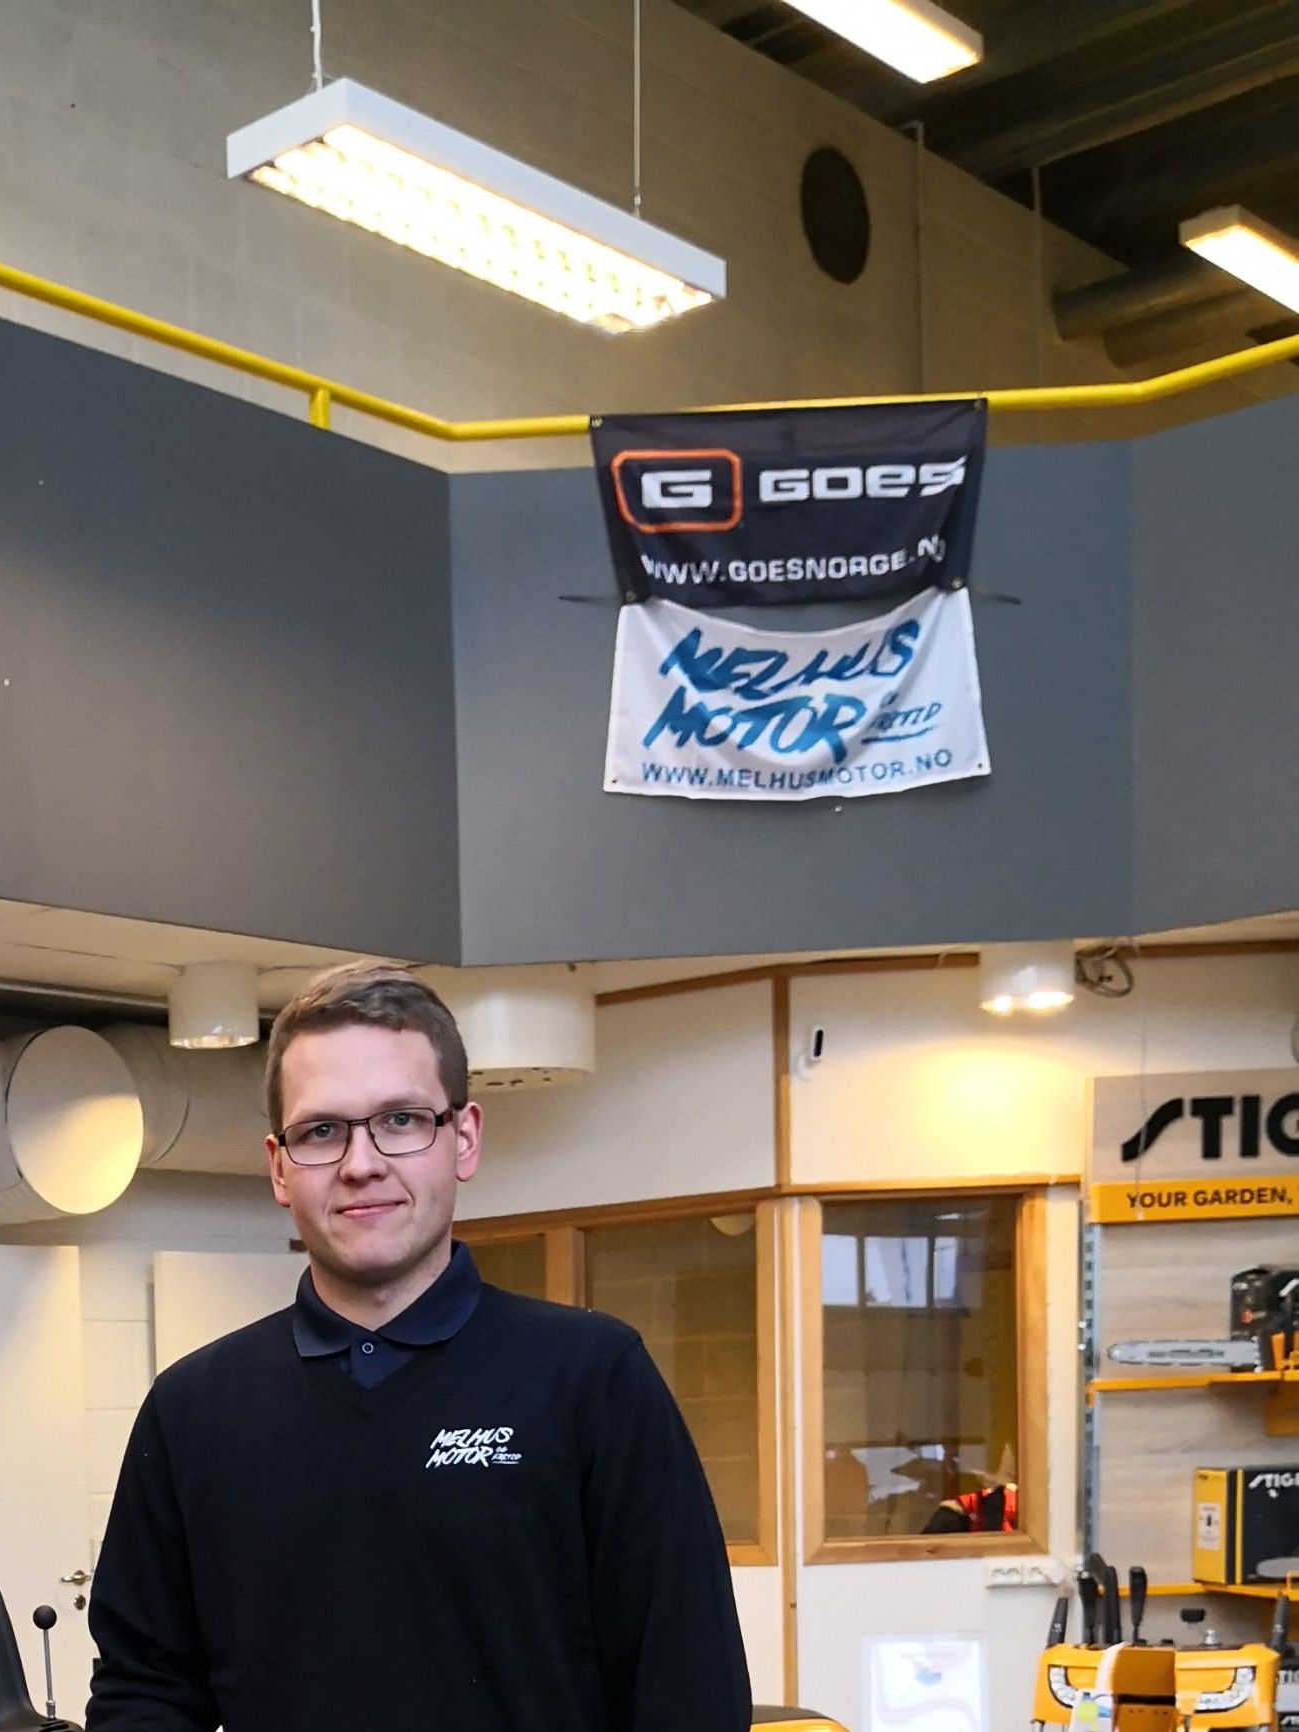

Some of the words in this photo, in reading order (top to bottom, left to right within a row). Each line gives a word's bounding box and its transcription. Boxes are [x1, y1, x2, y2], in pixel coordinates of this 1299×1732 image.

[641, 470, 713, 509] G
[658, 619, 921, 700] MELHUS
[643, 686, 867, 764] MOTOR
[642, 749, 953, 790] WWW.MELHUSMOTOR.NO
[1127, 1191, 1187, 1208] YOUR
[1189, 1187, 1293, 1207] GARDEN,
[425, 1446, 494, 1468] MOTOR
[430, 1427, 514, 1449] MELHUS
